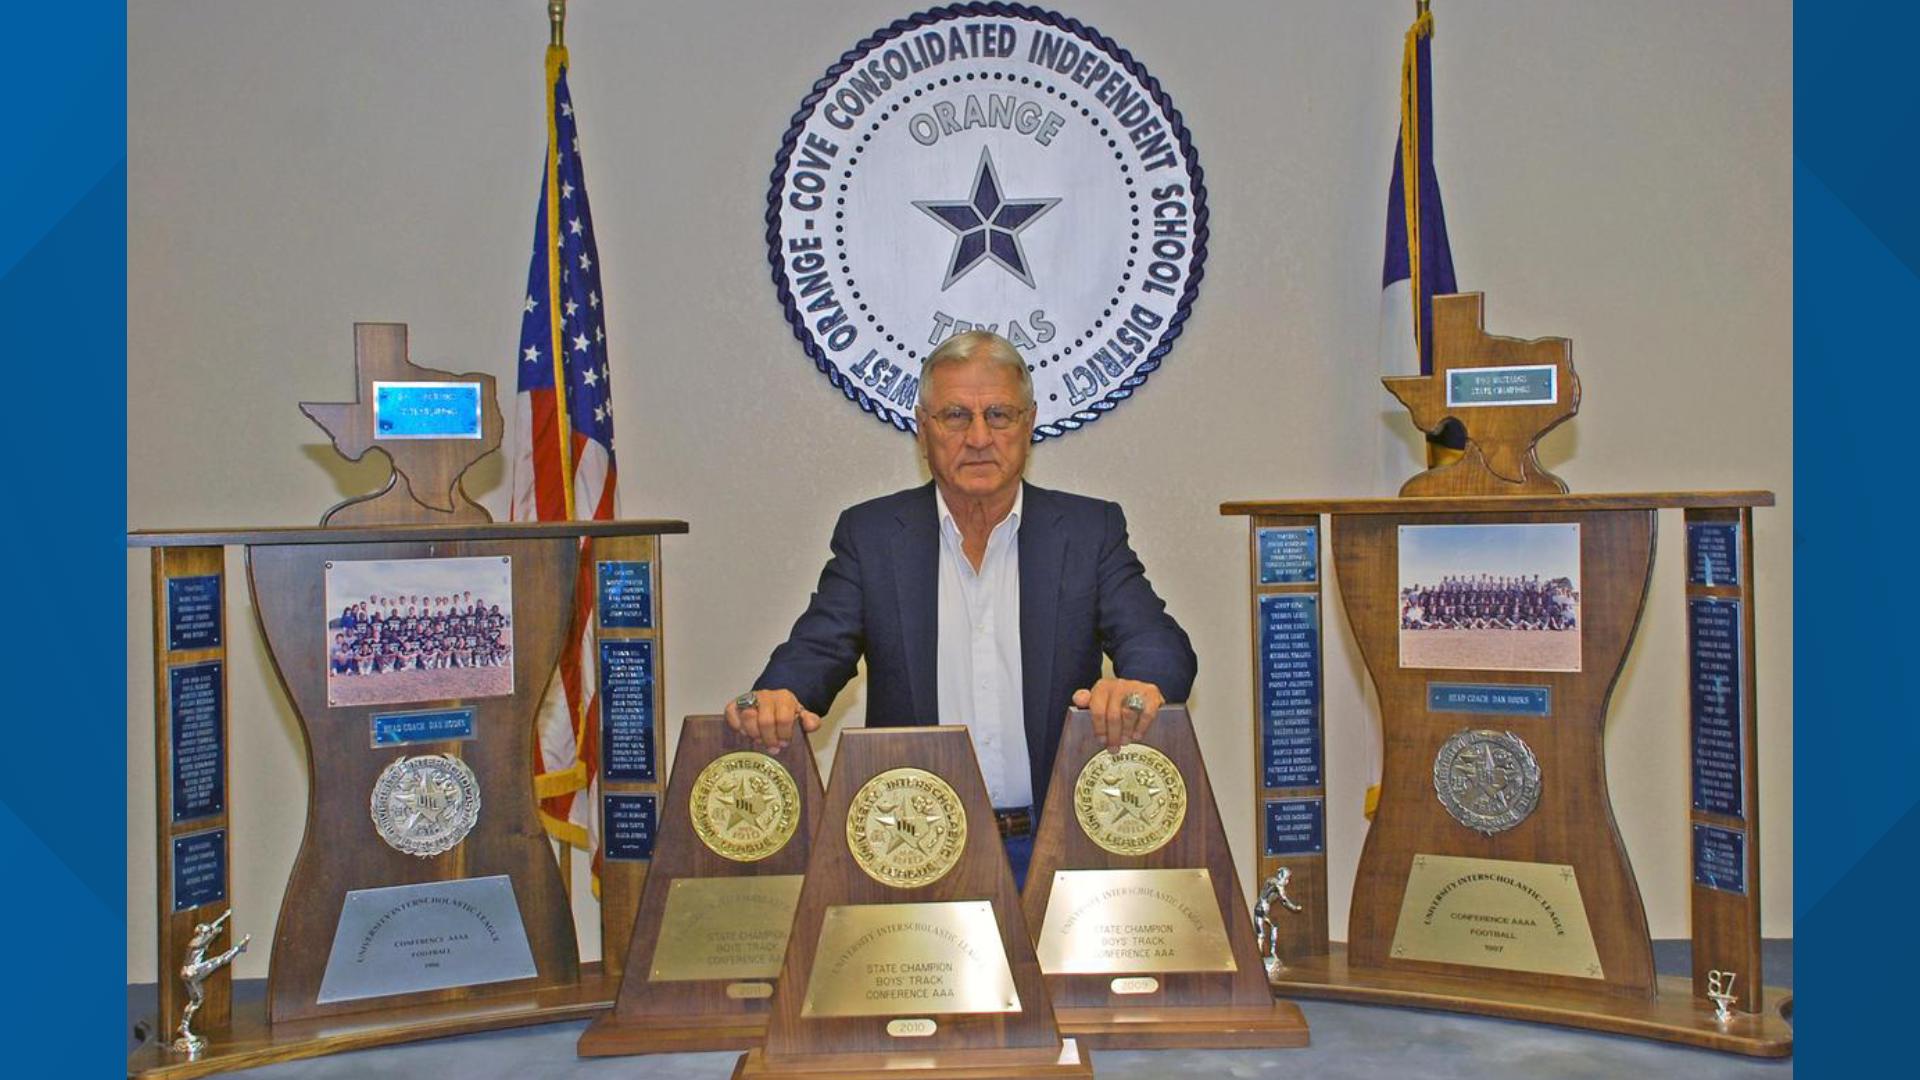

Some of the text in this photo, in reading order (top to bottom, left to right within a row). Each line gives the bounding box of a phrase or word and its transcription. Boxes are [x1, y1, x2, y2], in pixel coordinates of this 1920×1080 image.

[824, 23, 1017, 131] CONSOLIDATED
[1028, 29, 1177, 172] INDEPENDENT
[908, 94, 1066, 147] ORANGE
[789, 132, 839, 212] COVE
[1143, 182, 1187, 297] SCHOOL
[789, 235, 858, 352] ORANGE
[927, 309, 1057, 350] TAS
[1062, 303, 1164, 405] DISTRICT
[849, 348, 919, 411] WEST
[1423, 873, 1566, 937] UNIVERSITY INTERSCHOLASTIC LEAGUE
[1124, 923, 1174, 934] CHAMPION
[1450, 911, 1537, 927] CONFERENCE AAAA
[356, 912, 393, 964] UNIVERSITY
[393, 936, 444, 948] CONFERENCE
[876, 921, 958, 944] INTERSCHOLASTIC
[1132, 936, 1165, 946] TRACK
[1470, 928, 1518, 940] FOOTBALL
[1094, 949, 1175, 960] ONFERENCE AAA
[866, 962, 953, 975] STATE CHAMPION
[909, 975, 944, 986] TRACK
[865, 988, 955, 1000] CONFERENCE AAA
[1708, 970, 1736, 996] 87
[899, 1022, 926, 1033] 2010
